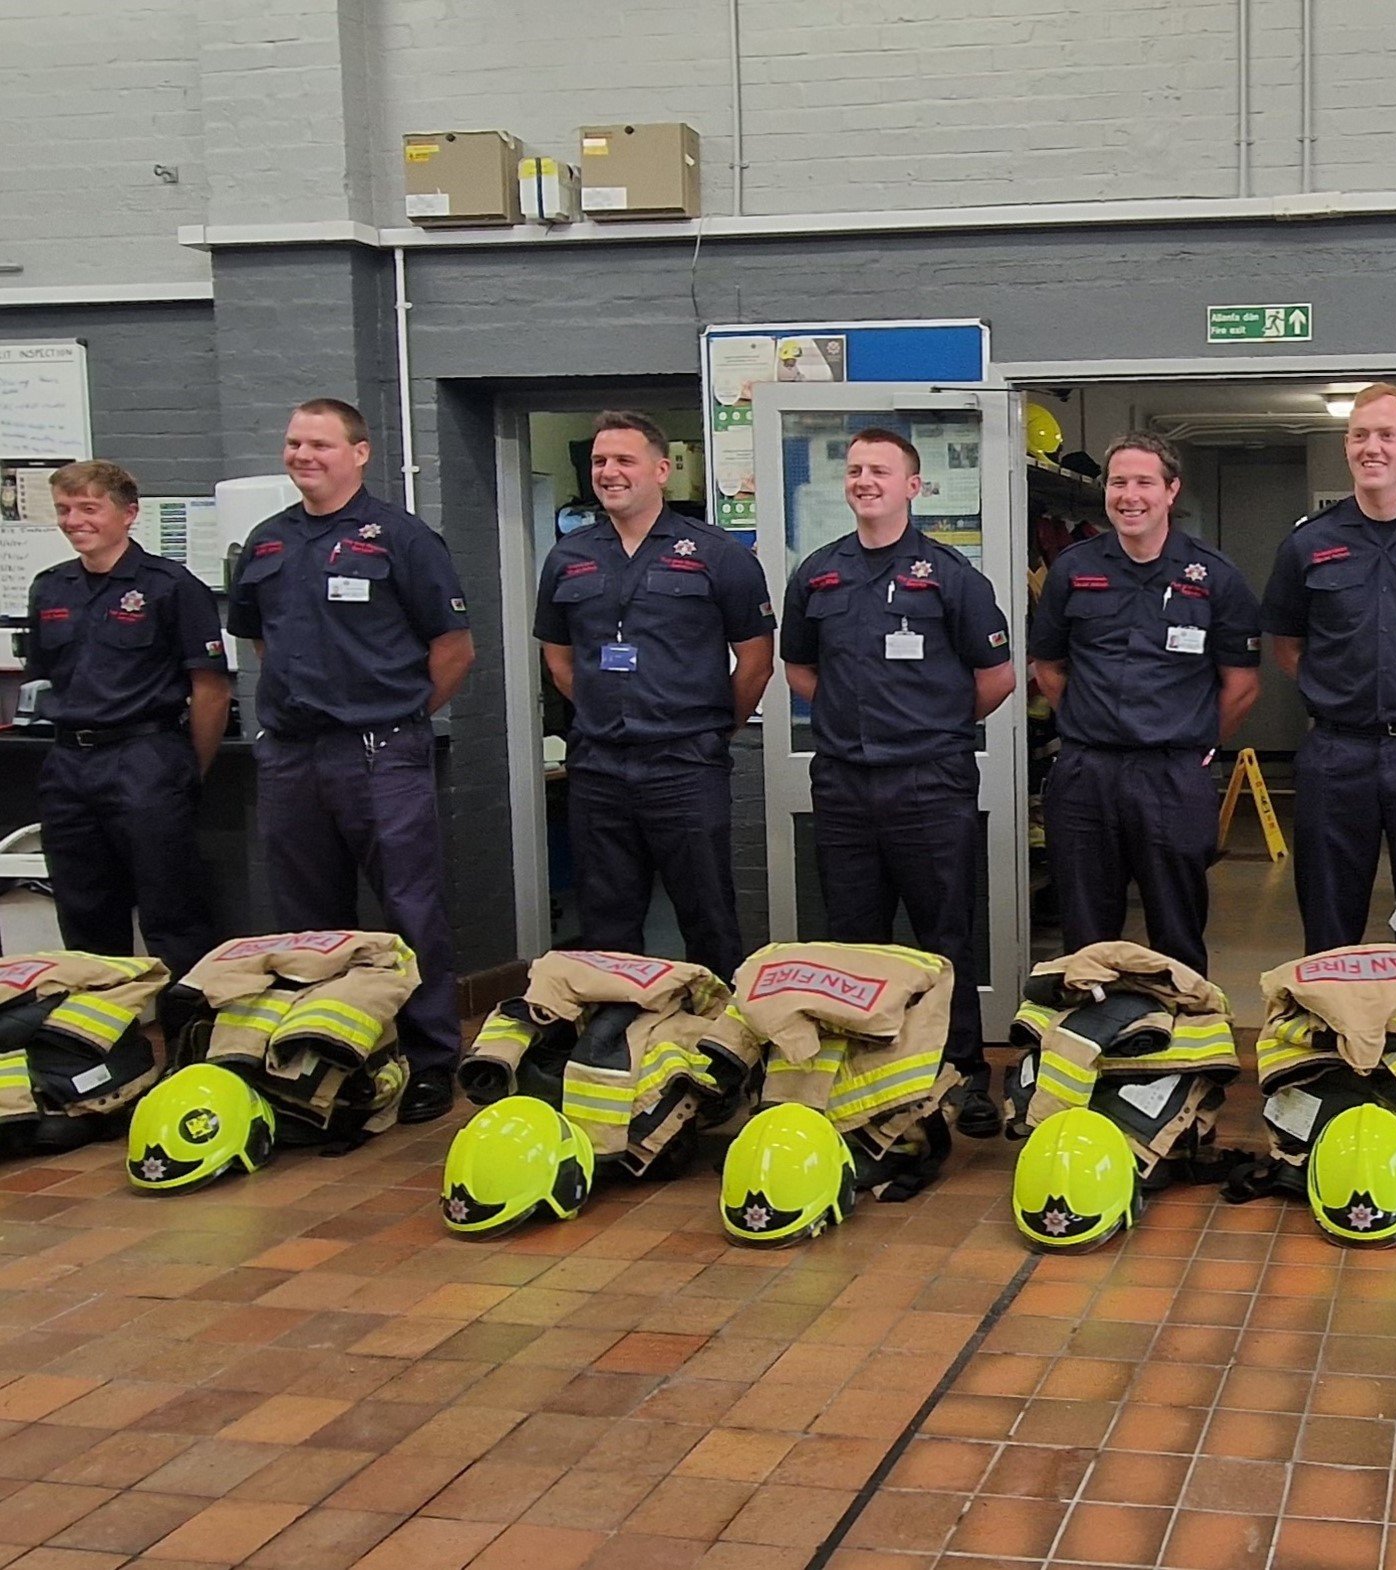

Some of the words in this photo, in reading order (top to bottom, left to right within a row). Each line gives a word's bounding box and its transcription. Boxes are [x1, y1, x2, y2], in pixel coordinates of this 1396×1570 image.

[1211, 326, 1227, 335] Fire
[1229, 326, 1246, 335] exit
[606, 962, 653, 976] TAN
[1305, 959, 1361, 974] FIRE
[760, 967, 816, 987] FIRE
[820, 973, 867, 1001] TAN
